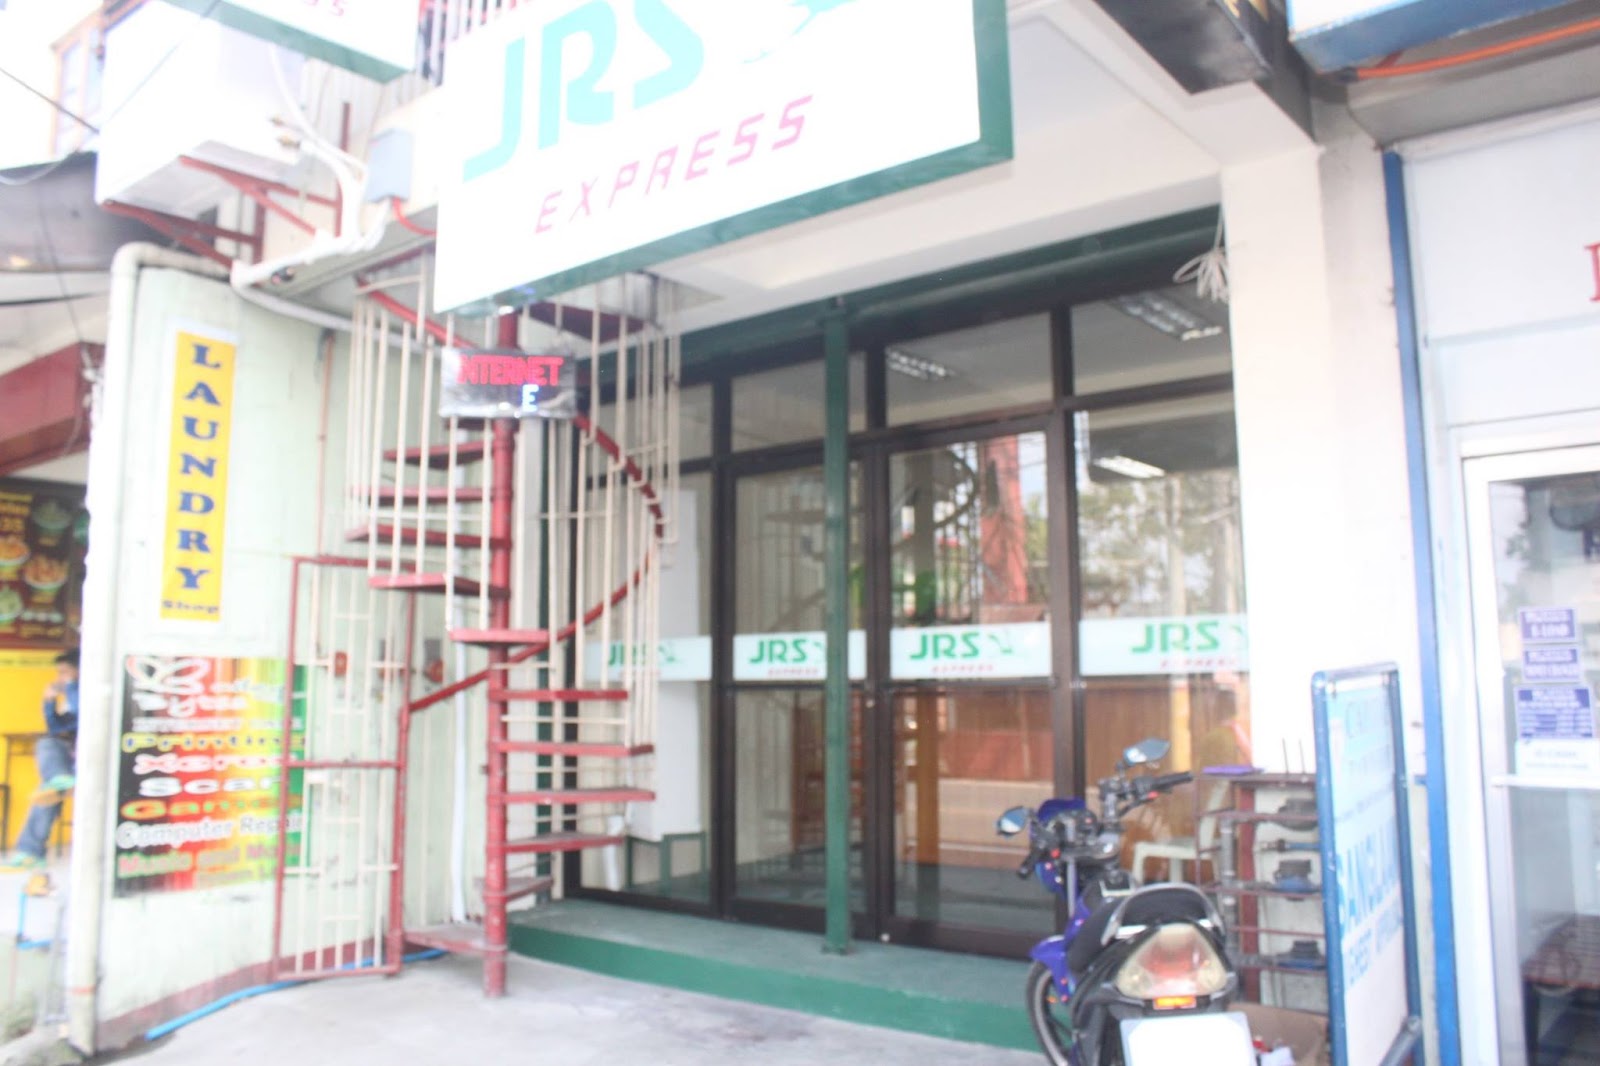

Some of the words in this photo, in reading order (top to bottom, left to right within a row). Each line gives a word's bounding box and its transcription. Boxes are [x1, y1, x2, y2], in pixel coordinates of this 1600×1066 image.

[462, 0, 705, 182] JRS
[534, 94, 814, 235] EXPRESS
[175, 342, 222, 590] LAUNDRY
[749, 638, 807, 665] JRS
[909, 632, 980, 660] JRS
[1130, 620, 1220, 654] JRS
[239, 812, 304, 837] Repir
